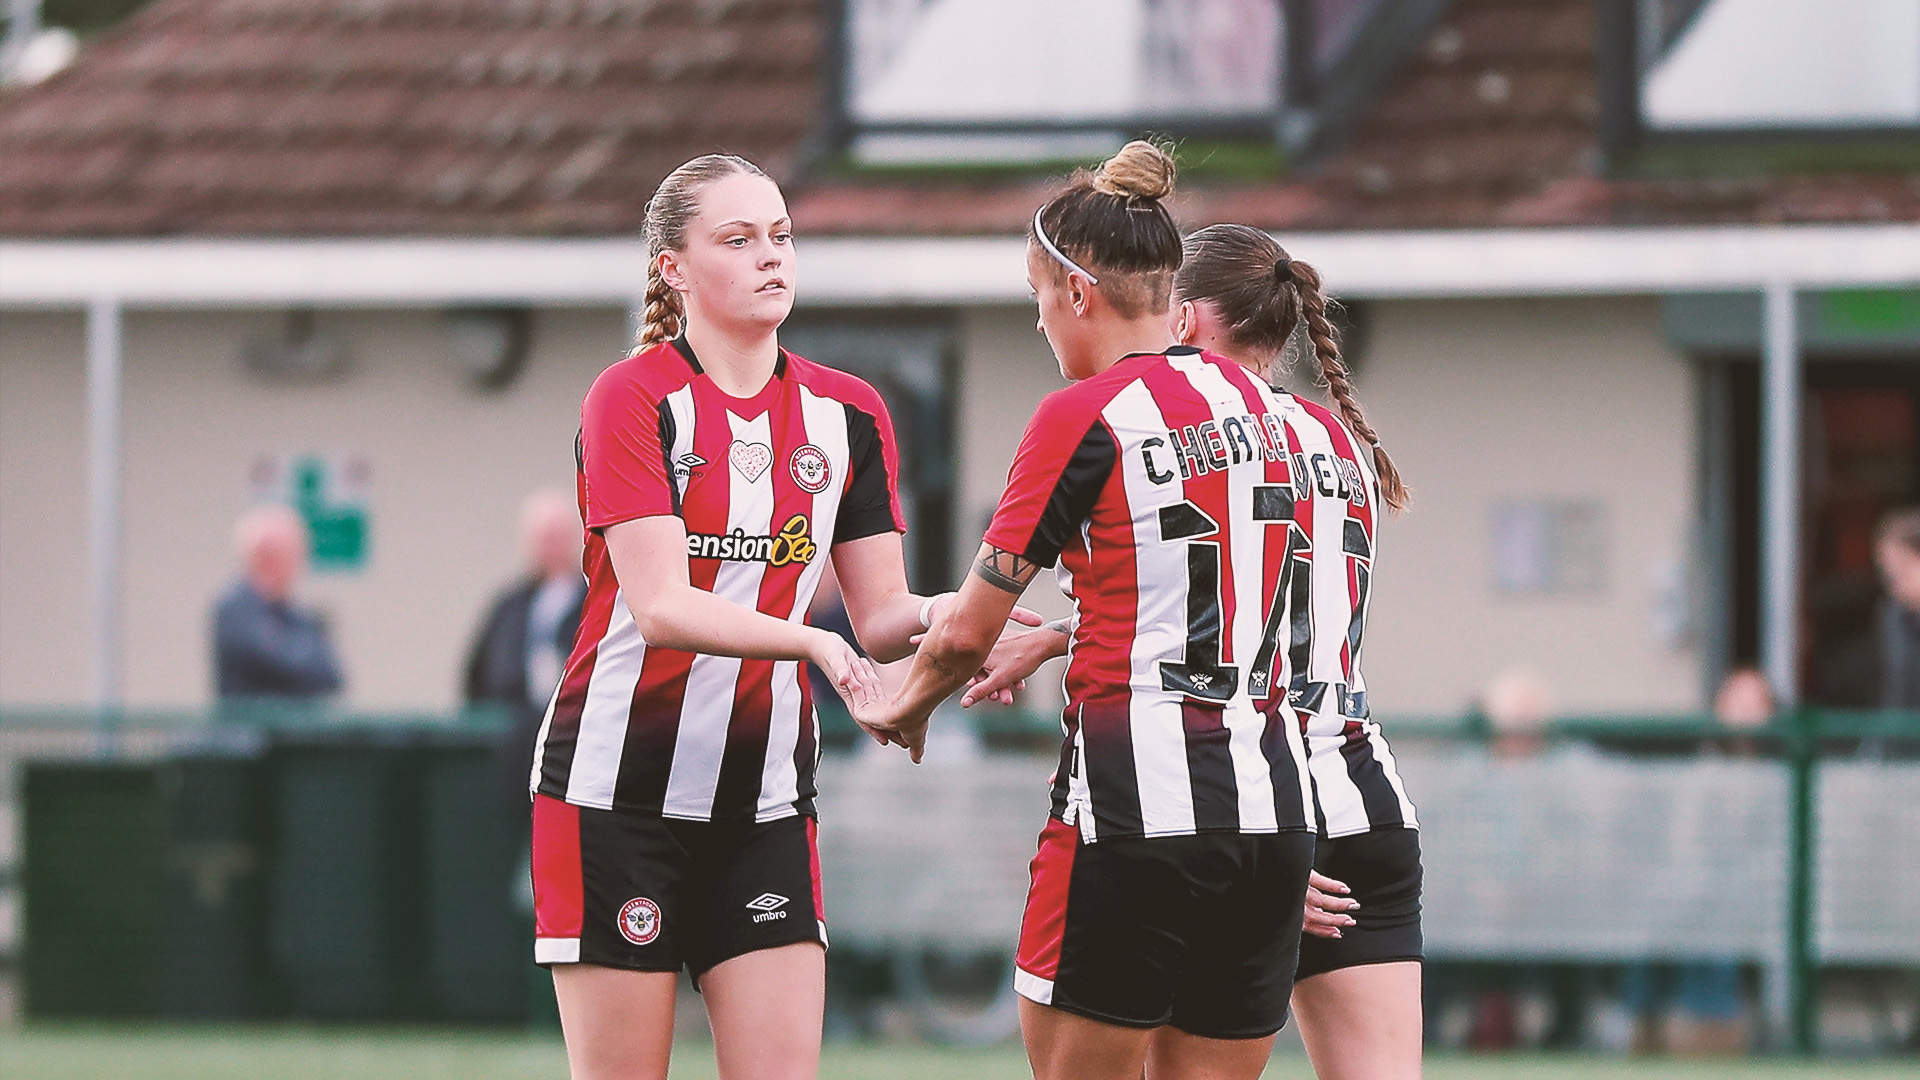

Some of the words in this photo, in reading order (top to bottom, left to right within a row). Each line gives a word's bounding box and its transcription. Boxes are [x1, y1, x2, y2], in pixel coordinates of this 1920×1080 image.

[686, 514, 816, 566] ensionBee
[1159, 487, 1295, 700] 17
[752, 909, 787, 923] umbro
